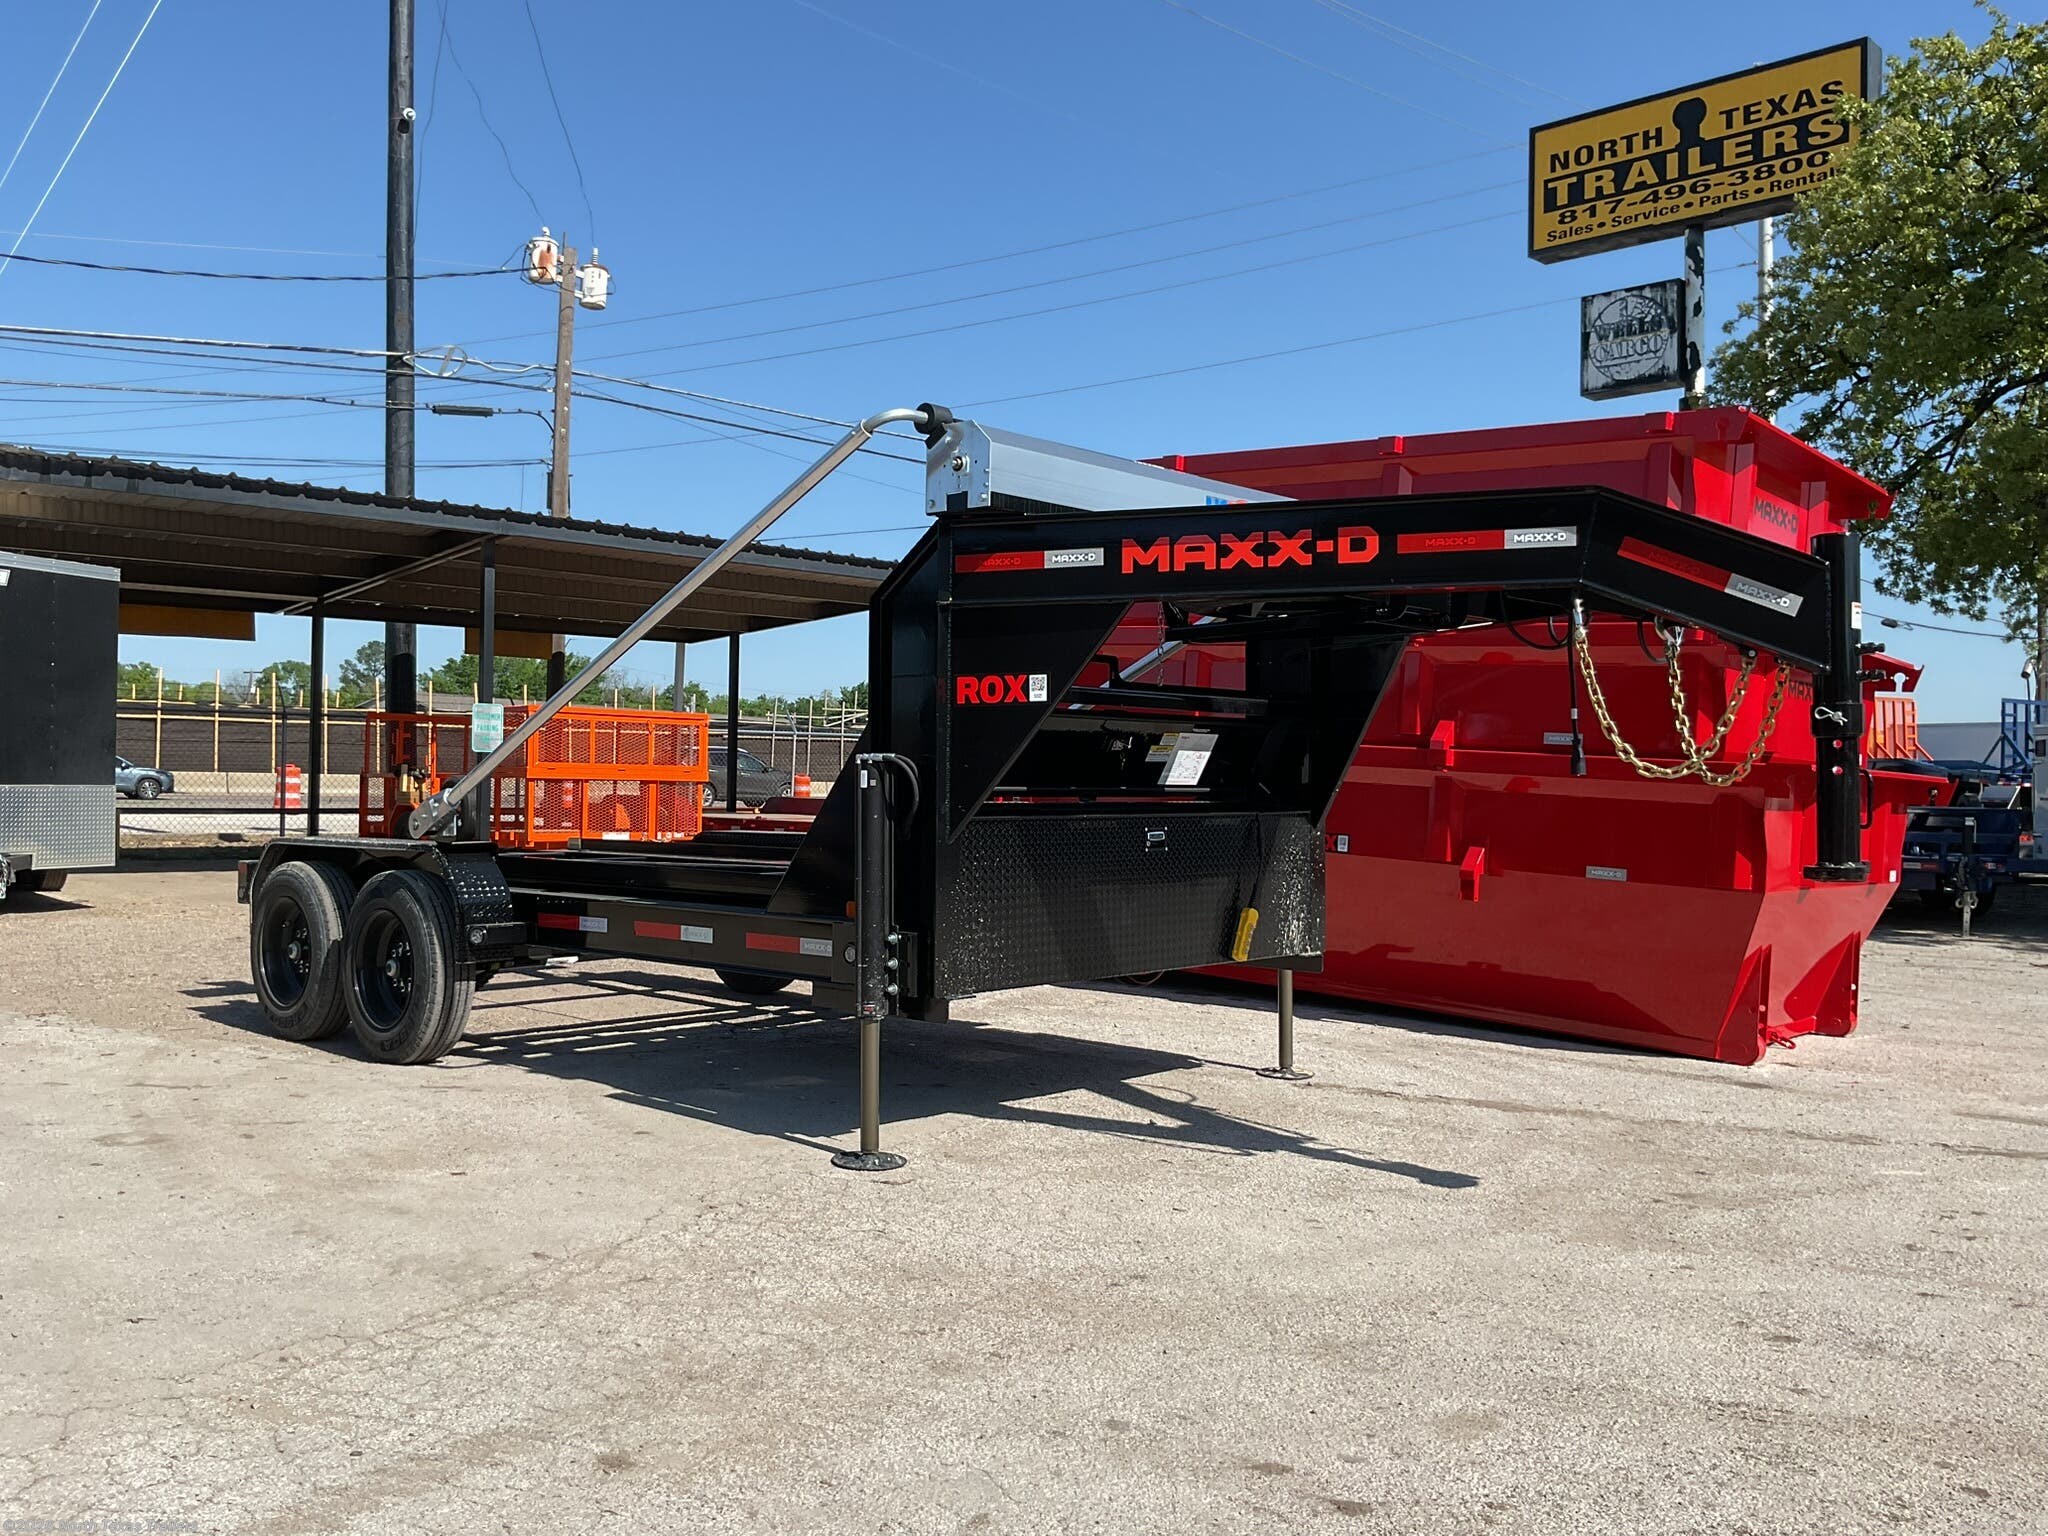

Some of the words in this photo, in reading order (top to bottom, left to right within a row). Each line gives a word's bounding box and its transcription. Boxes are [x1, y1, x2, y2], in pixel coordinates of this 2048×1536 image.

[1550, 126, 1663, 174] NORTH
[1718, 80, 1844, 130] TEXAS
[1548, 111, 1845, 208] TRAILERS
[1558, 150, 1831, 225] 817-496-3800
[1547, 222, 1594, 243] Sales
[1611, 204, 1681, 228] Service
[1699, 189, 1750, 208] Parts
[1594, 333, 1663, 363] CARGO
[1051, 552, 1096, 564] MAXX-D
[1121, 525, 1380, 574] MAXX-D
[1513, 531, 1567, 544] MAXX-D
[957, 674, 1028, 704] ROX
